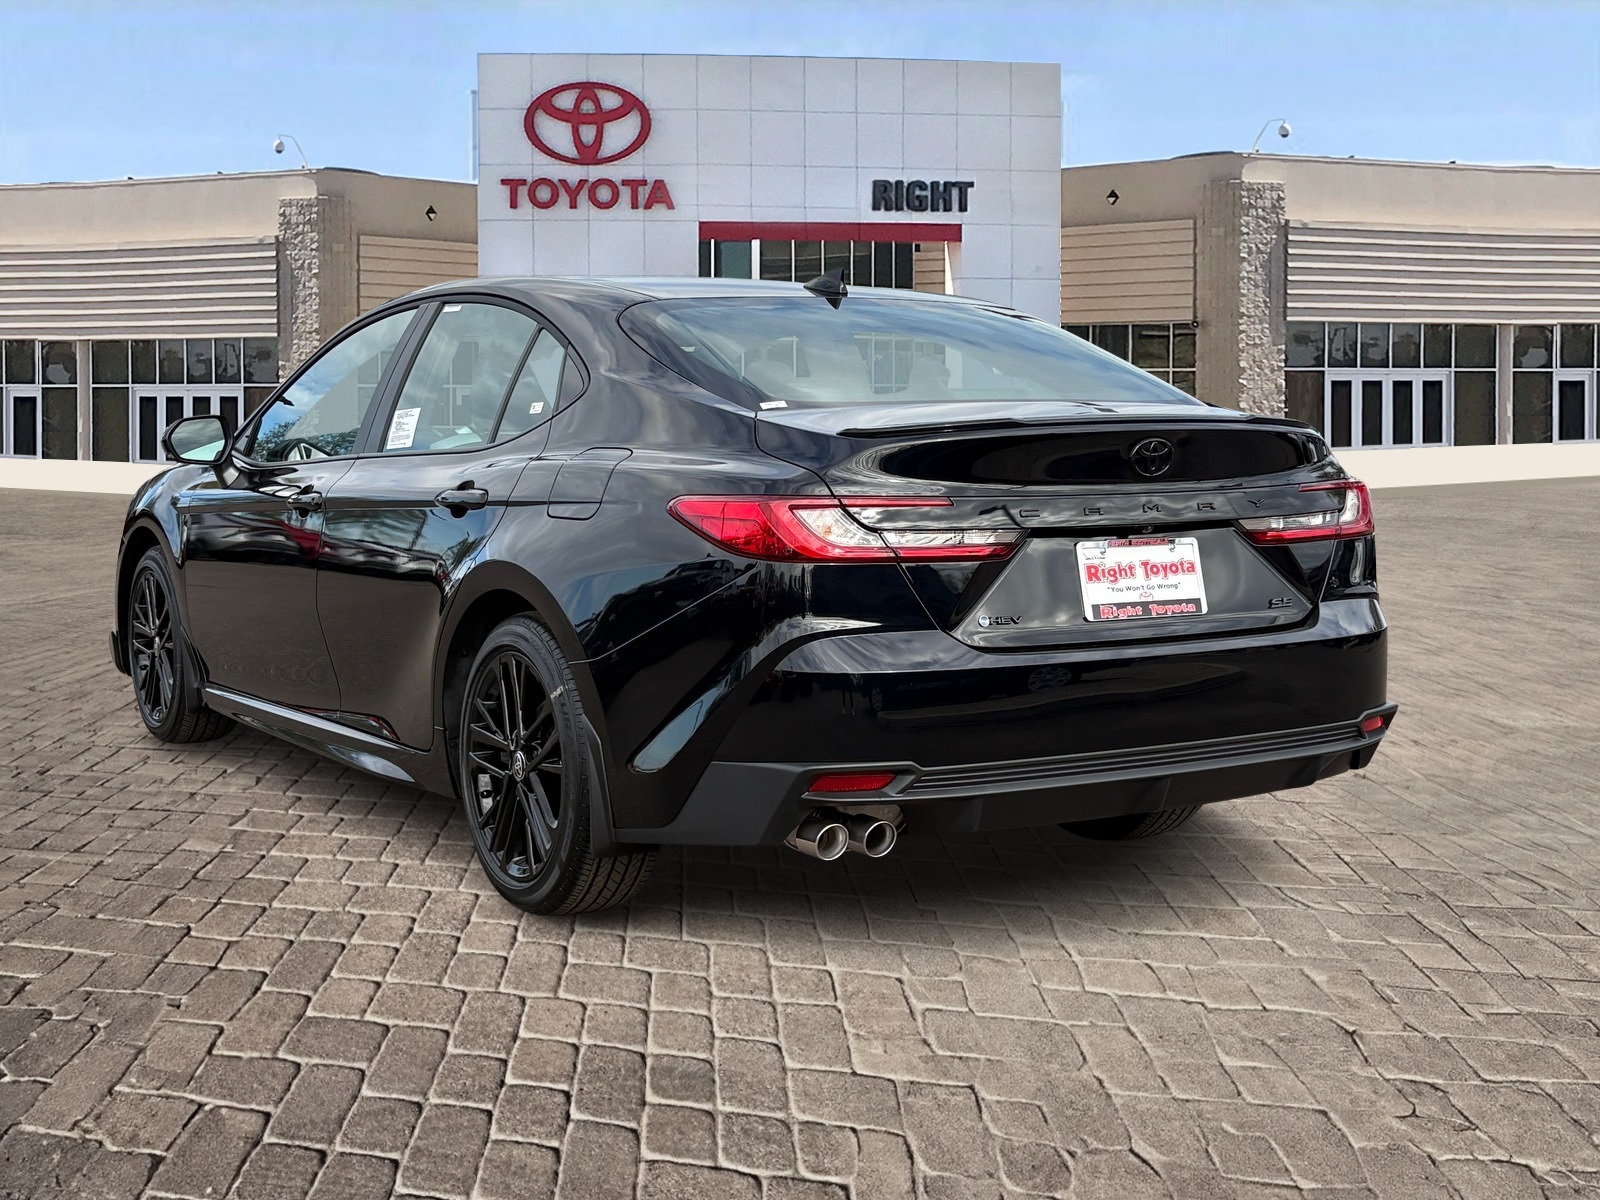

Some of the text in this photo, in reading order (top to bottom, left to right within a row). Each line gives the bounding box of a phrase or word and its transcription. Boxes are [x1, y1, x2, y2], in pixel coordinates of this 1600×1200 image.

[500, 178, 675, 210] TOYOTA
[871, 180, 975, 213] RIGHT
[1018, 498, 1265, 518] CAMRY
[1085, 559, 1196, 584] Right Toyota
[1125, 584, 1145, 592] Won't
[1146, 583, 1156, 591] Go
[1100, 602, 1197, 619] Right Toyota
[1268, 597, 1293, 609] SE
